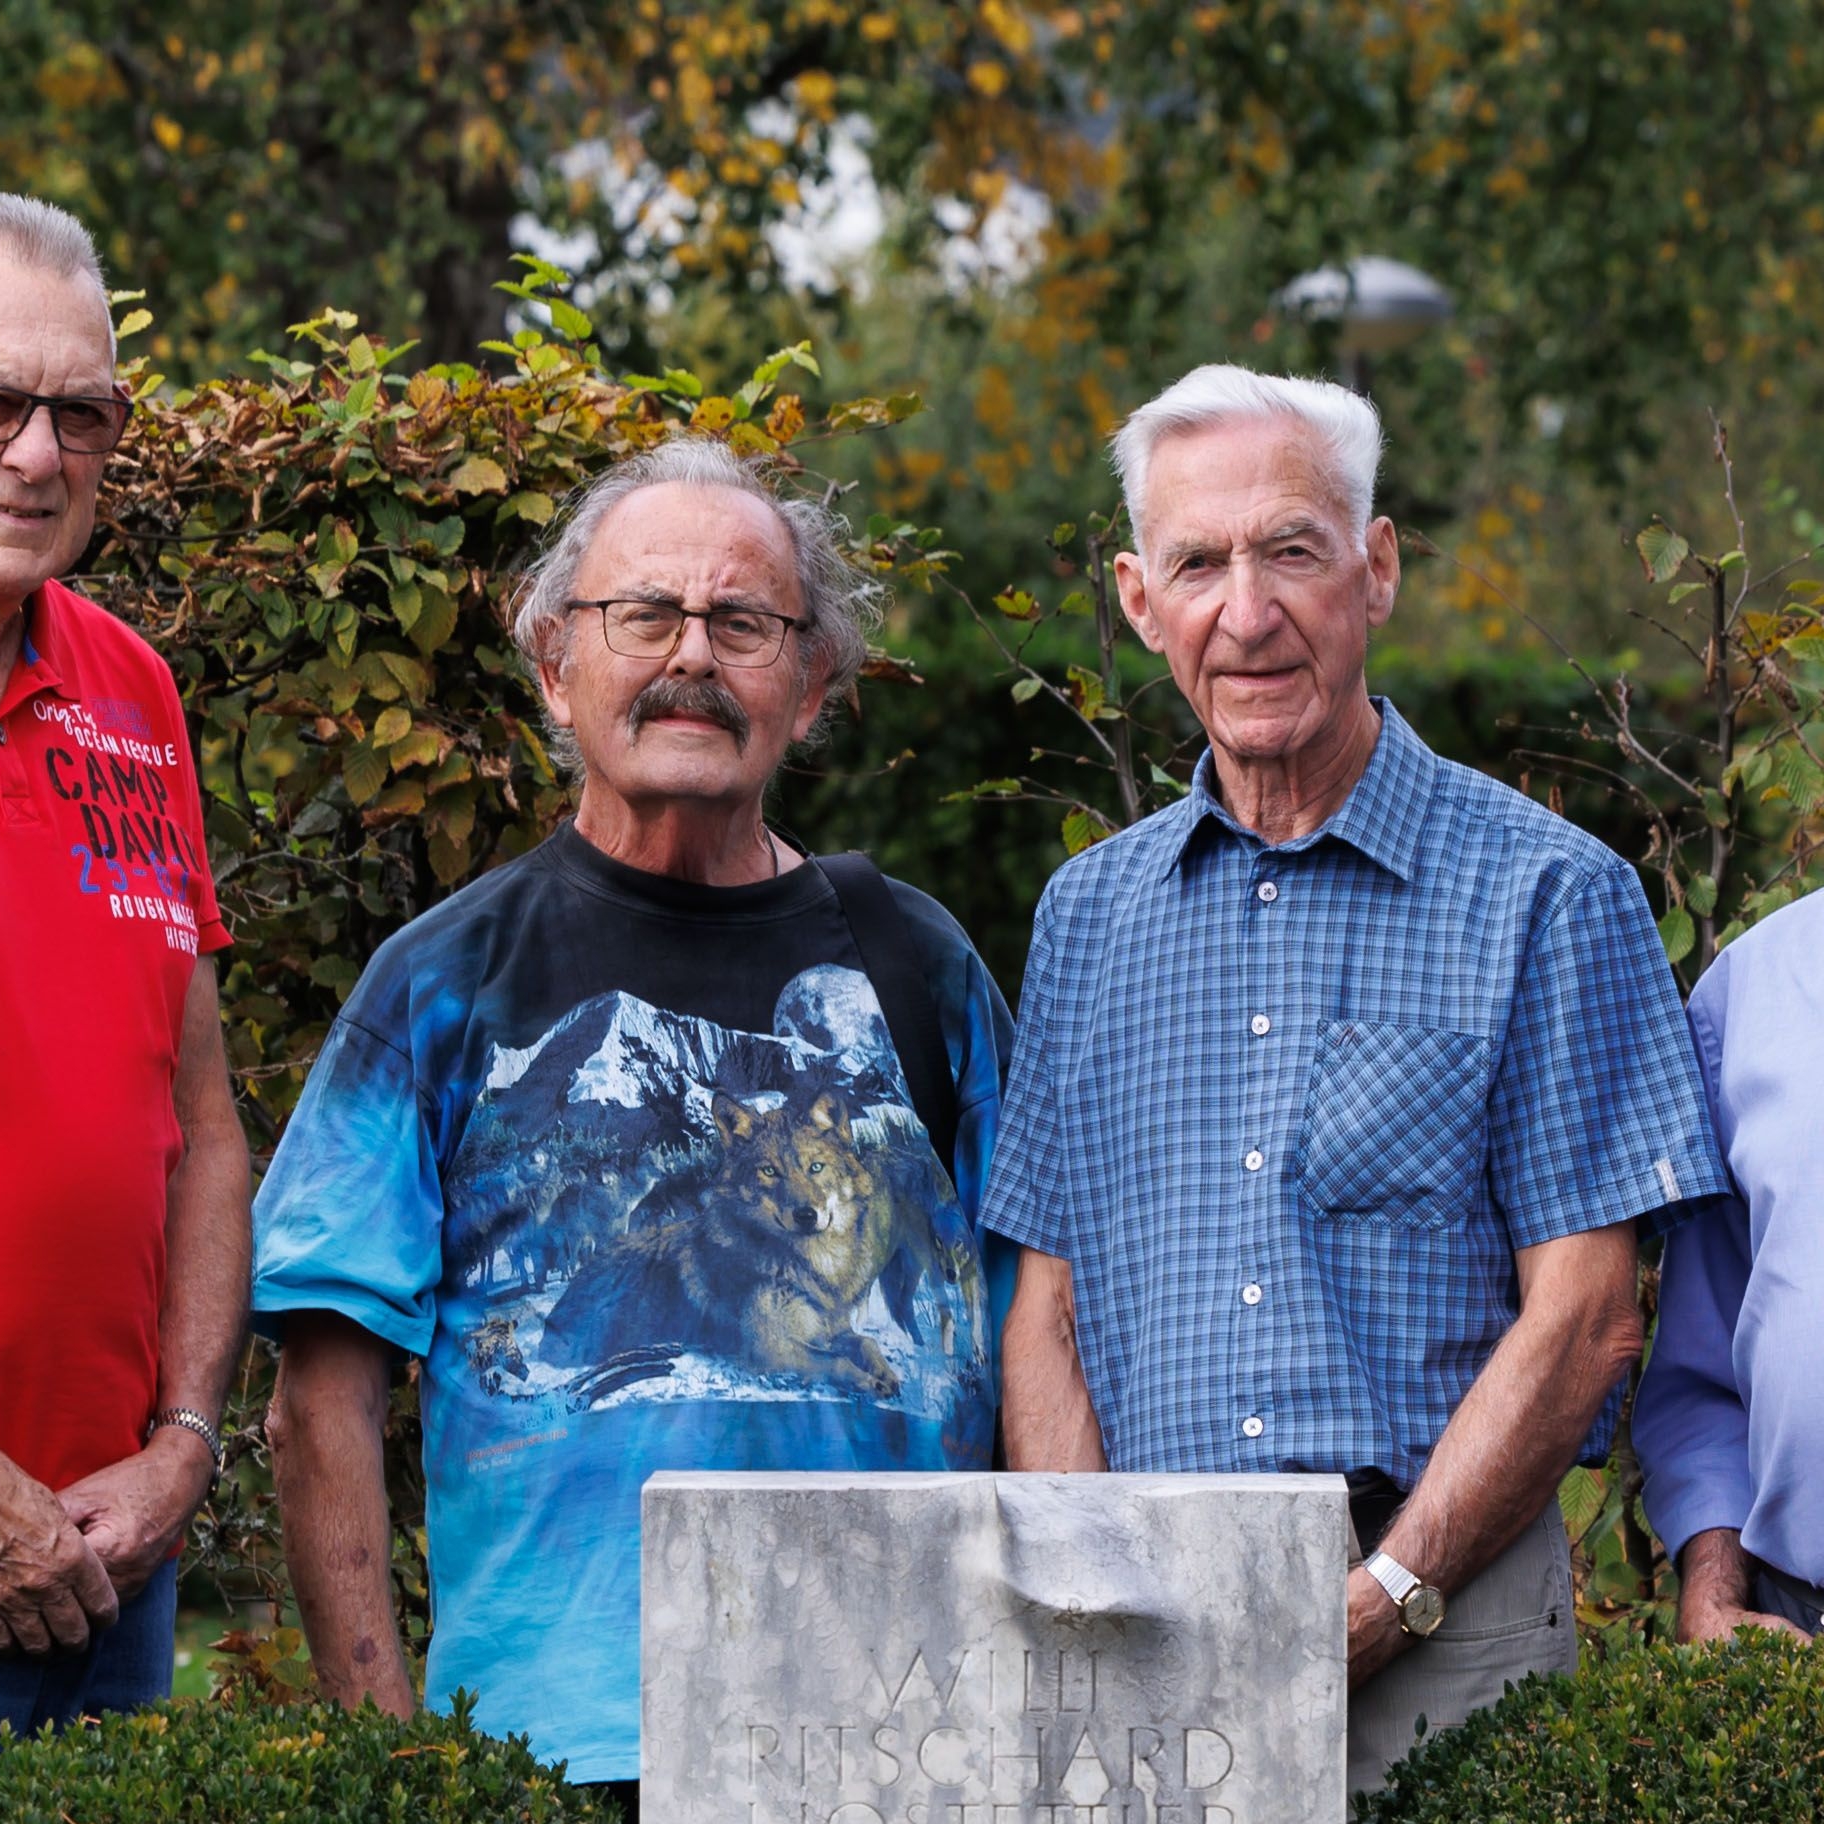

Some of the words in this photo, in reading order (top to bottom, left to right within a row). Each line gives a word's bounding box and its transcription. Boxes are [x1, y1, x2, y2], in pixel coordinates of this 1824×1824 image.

[74, 726, 121, 756] OCEAN
[121, 737, 177, 766] RESCUE
[45, 747, 168, 816] CAMP
[109, 895, 168, 922] ROUGH
[876, 1649, 1100, 1713] WILLI
[748, 1725, 1235, 1790] RITSCHARD
